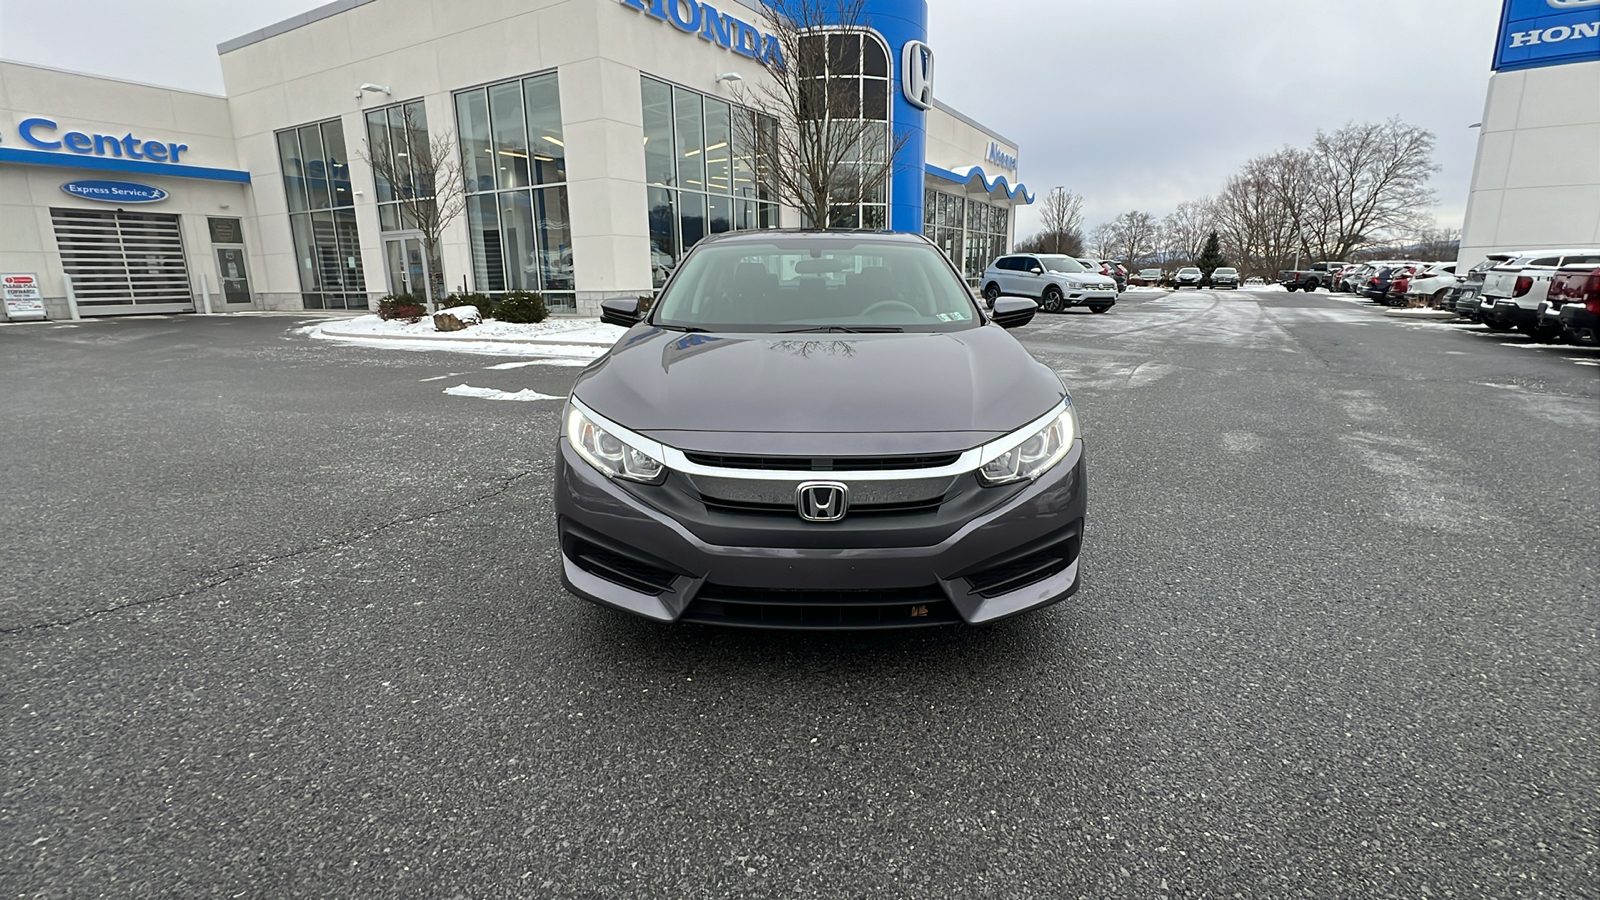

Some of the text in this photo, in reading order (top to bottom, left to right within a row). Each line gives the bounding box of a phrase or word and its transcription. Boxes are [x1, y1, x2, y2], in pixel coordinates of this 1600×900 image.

[1508, 22, 1600, 48] HON
[18, 117, 188, 163] Center
[69, 184, 148, 197] Express Service
